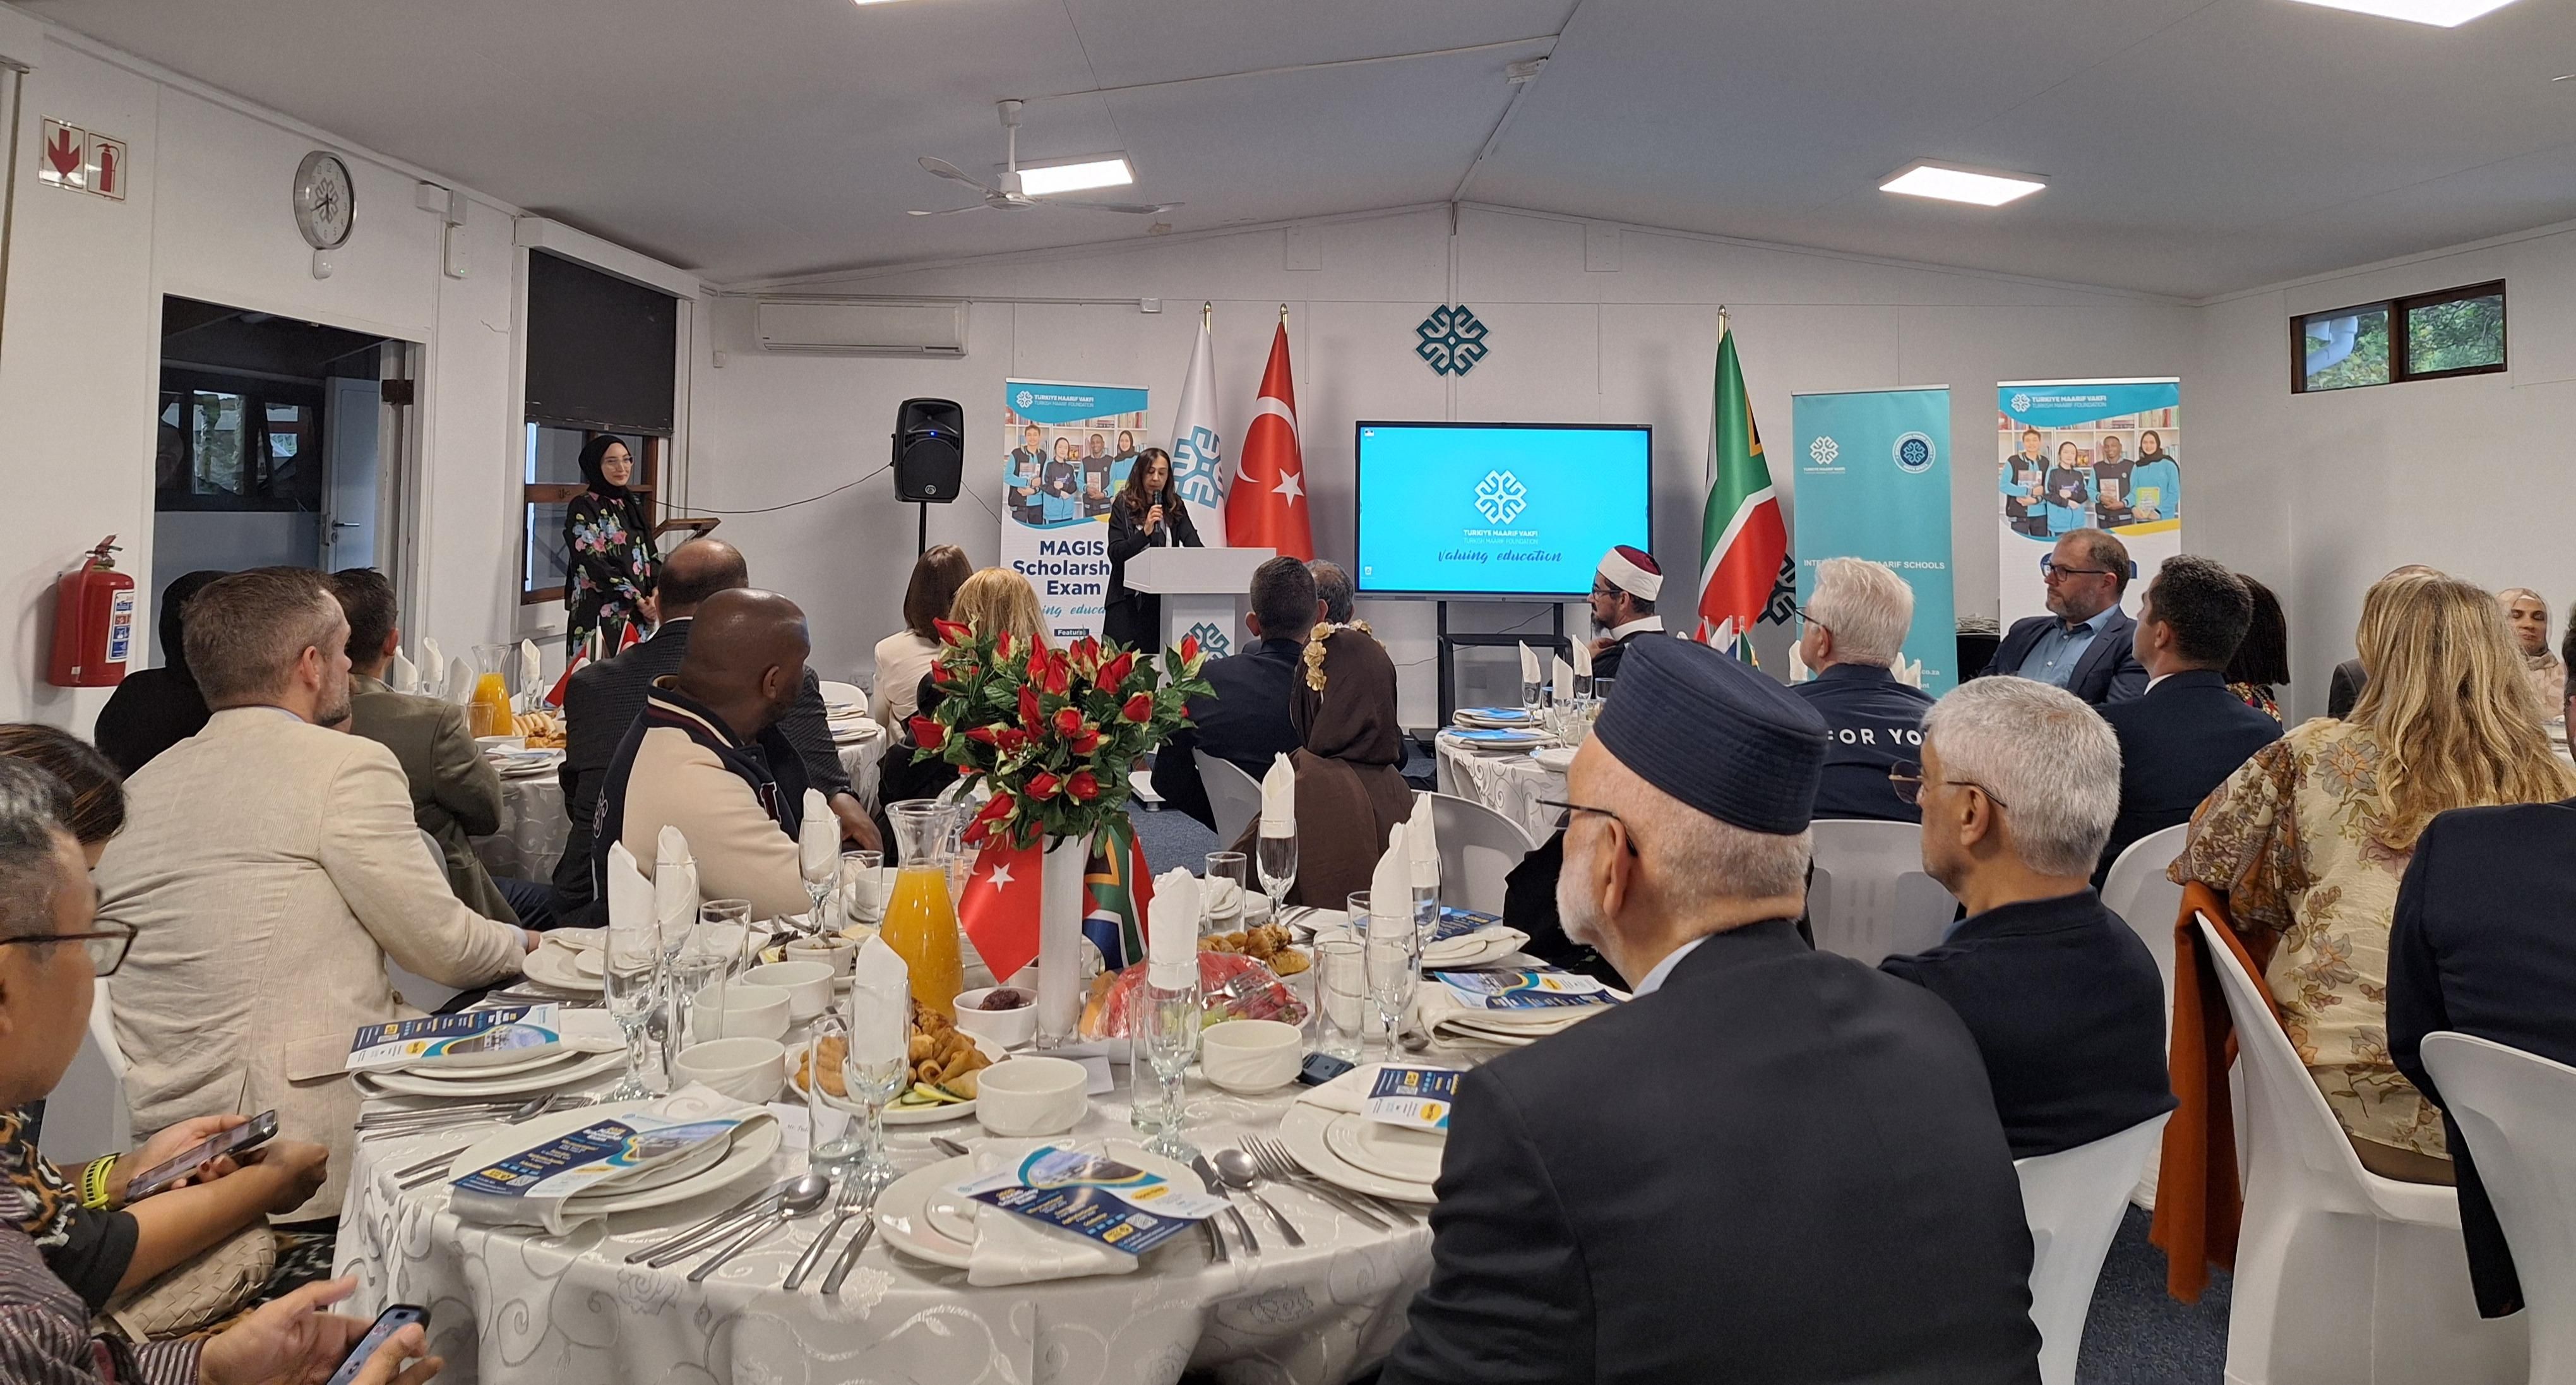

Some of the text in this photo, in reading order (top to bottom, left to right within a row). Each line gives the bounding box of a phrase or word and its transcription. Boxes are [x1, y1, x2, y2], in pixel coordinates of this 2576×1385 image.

[1040, 541, 1104, 556] MAGIS
[1496, 549, 1563, 562] education
[1013, 560, 1110, 575] Scholarsh
[1047, 580, 1100, 595] Exam
[1070, 604, 1106, 615] educa
[1888, 728, 1926, 746] YO
